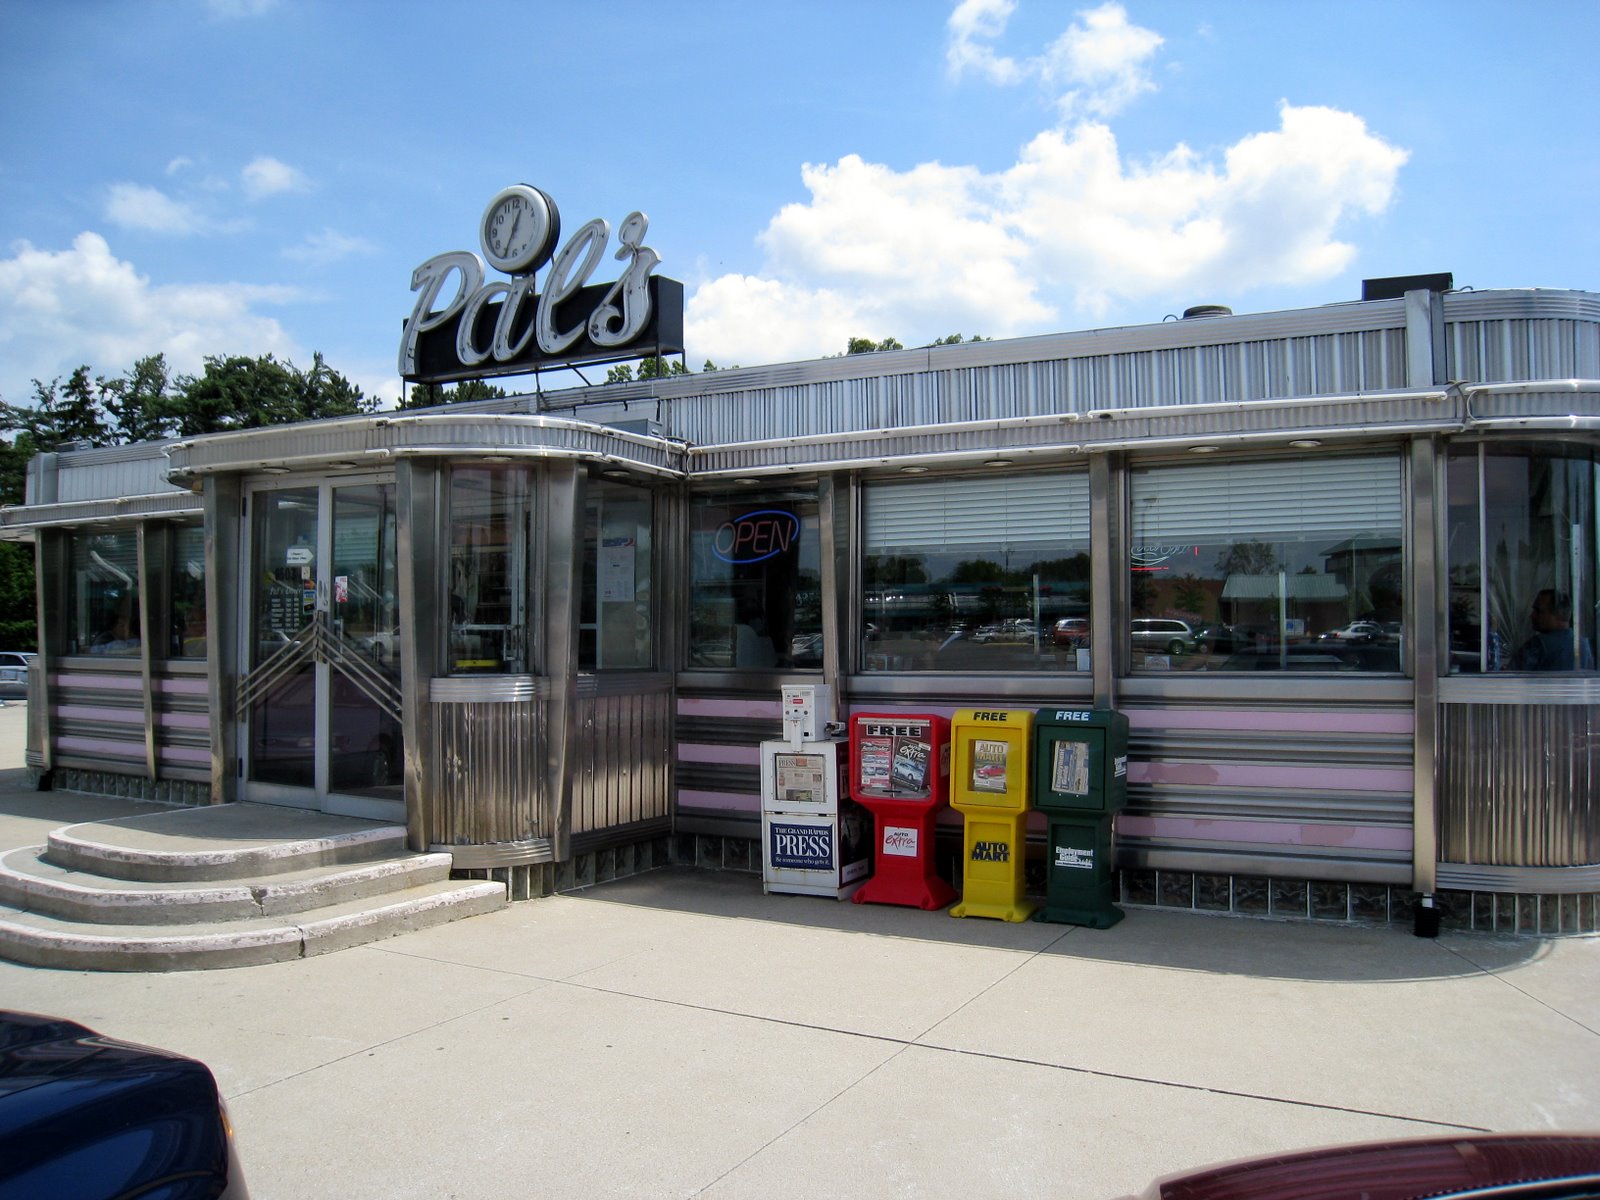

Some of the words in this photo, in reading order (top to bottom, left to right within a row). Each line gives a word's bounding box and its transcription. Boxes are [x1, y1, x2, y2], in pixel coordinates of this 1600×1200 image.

[504, 204, 511, 213] 11
[512, 199, 520, 209] 12
[495, 215, 504, 225] 10
[491, 228, 498, 238] 9
[511, 249, 518, 257] 6
[398, 211, 662, 376] Pal's
[716, 520, 792, 553] OPEN
[973, 712, 1008, 721] FREE
[1055, 711, 1090, 721] FREE
[867, 725, 920, 737] FREE
[979, 743, 1004, 753] AUTO
[808, 828, 829, 836] RAPIDS
[775, 834, 830, 858] PRESS
[885, 835, 915, 850] extra
[974, 841, 1009, 852] AUTO
[972, 850, 1010, 862] MART
[1055, 846, 1093, 857] Employment
